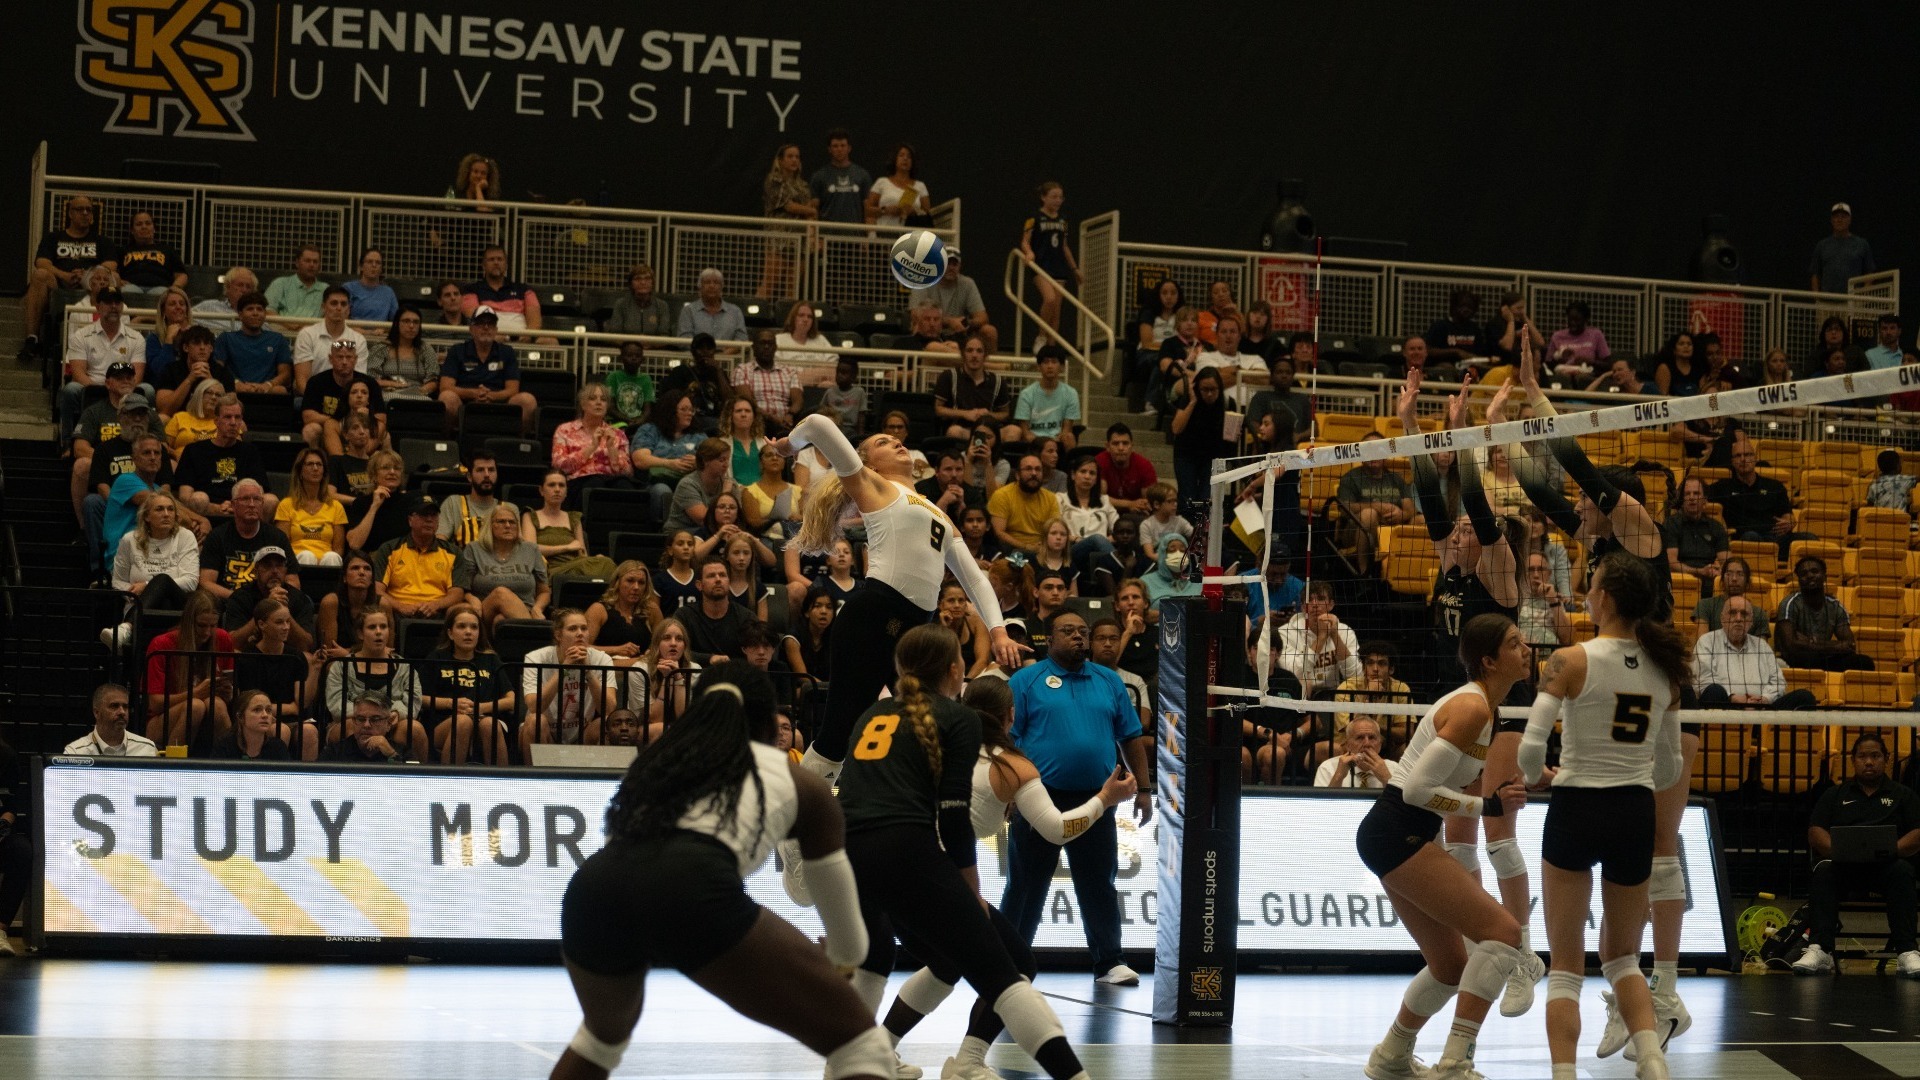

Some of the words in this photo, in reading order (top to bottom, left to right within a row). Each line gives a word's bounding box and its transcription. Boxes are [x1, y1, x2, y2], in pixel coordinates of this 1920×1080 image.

[291, 5, 625, 67] KENNESAW
[640, 30, 801, 81] STATE
[289, 59, 800, 133] UNIVERSITY
[56, 247, 97, 259] OWLS
[123, 250, 166, 267] OWLS
[900, 258, 931, 275] molten
[1857, 327, 1874, 338] 103
[1758, 384, 1798, 405] OWLS
[1634, 401, 1670, 422] OWLS
[1523, 417, 1555, 436] OWLS
[1424, 431, 1453, 450] OWLS
[1334, 443, 1361, 460] OWLS
[930, 517, 946, 553] 9
[484, 563, 531, 575] KSU
[1443, 607, 1462, 637] 17
[1612, 691, 1651, 743] 5
[853, 712, 901, 762] 8
[69, 758, 91, 766] Wagner
[1880, 798, 1894, 807] WF
[72, 793, 355, 864] STUDY
[1203, 850, 1217, 896] sports
[1202, 897, 1217, 953] imports
